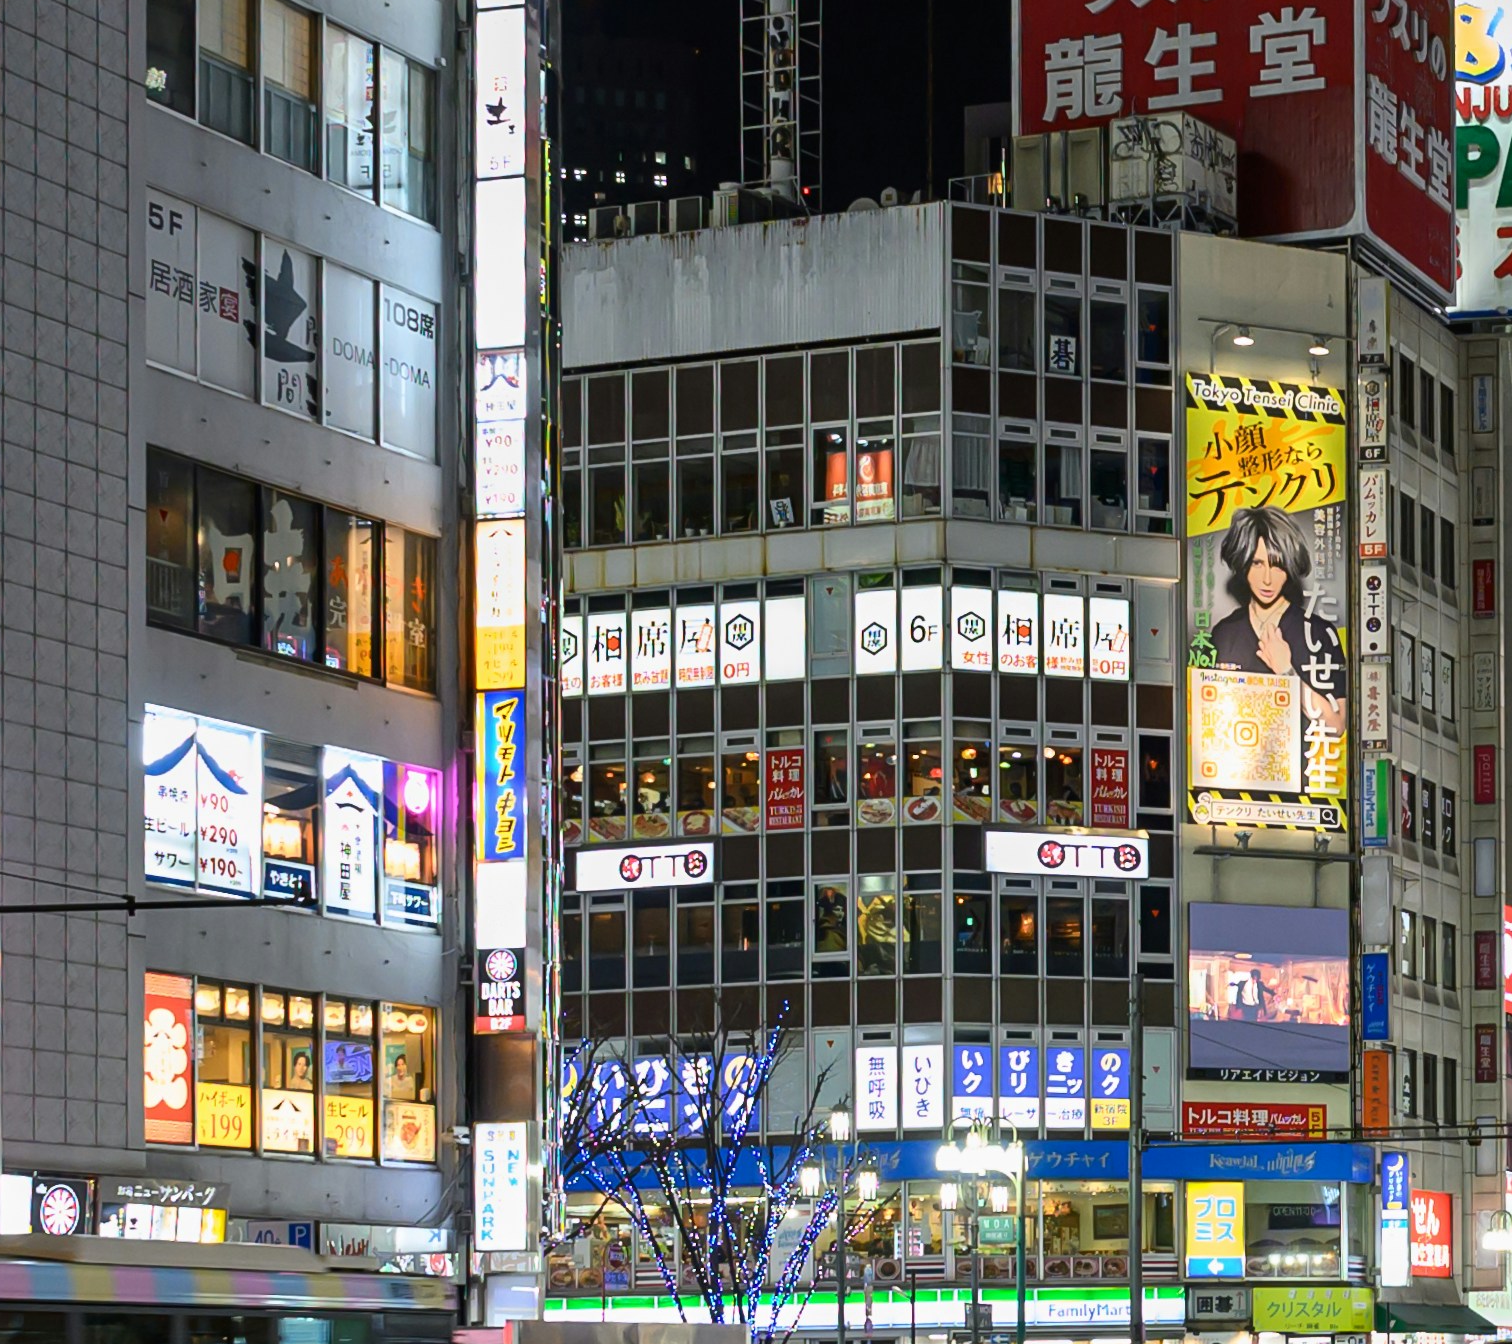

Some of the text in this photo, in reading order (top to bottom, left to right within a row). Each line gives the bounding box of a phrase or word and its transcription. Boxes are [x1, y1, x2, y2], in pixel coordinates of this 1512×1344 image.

[1041, 6, 1328, 123] 龍生堂
[1365, 72, 1453, 212] 龍生堂
[148, 201, 183, 237] 5F
[149, 258, 219, 316] 居酒家
[383, 296, 434, 341] 108席
[1050, 338, 1076, 372] 碁
[1193, 382, 1339, 413] Tokyo Tensei Clinic
[1204, 421, 1267, 461] 小顔
[1365, 447, 1383, 459] 6F
[1238, 441, 1323, 478] 整形なら
[1189, 462, 1336, 527] テンクリ
[1364, 543, 1384, 556] 5F
[910, 614, 939, 645] 6F
[1192, 611, 1215, 649] 日本
[1200, 672, 1247, 685] Instagram
[1301, 582, 1340, 796] たいせい先生
[491, 697, 519, 853] マツモトキヨシ
[200, 792, 229, 814] ¥90
[1365, 768, 1376, 829] FamilyMart
[1216, 806, 1316, 821] テンクリ たいせい先生
[199, 825, 238, 847] ¥290
[155, 850, 191, 867] サワー
[481, 981, 521, 1000] DARTS
[489, 999, 514, 1016] BAR
[199, 1090, 247, 1108] ハイボール
[868, 1056, 887, 1120] 無呼吸
[913, 1055, 932, 1119] いびき
[327, 1102, 369, 1118] 生ビール
[1102, 1116, 1119, 1126] 3F
[1187, 1108, 1270, 1127] トルコ料理
[296, 1226, 309, 1241] P
[1047, 1301, 1132, 1323] FamilyMart
[1196, 1295, 1233, 1313] 囲碁
[1266, 1300, 1342, 1319] クリスタル
